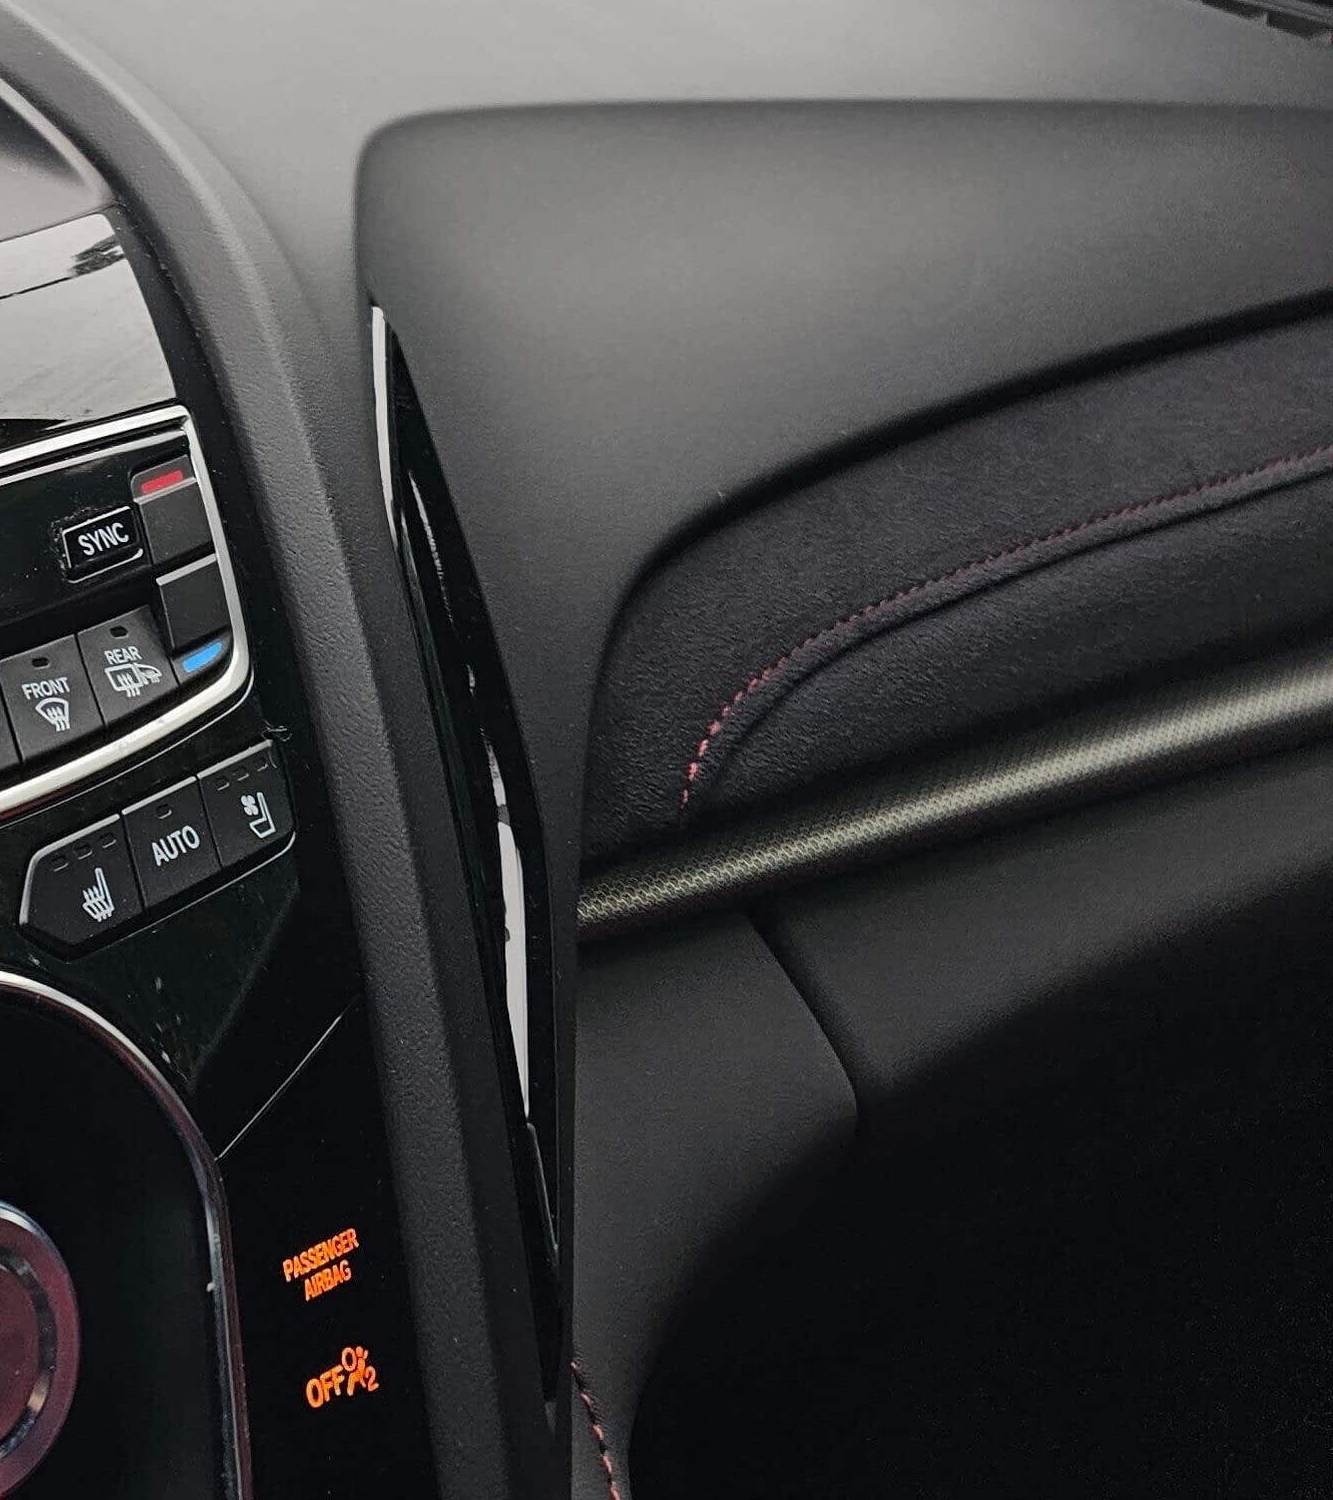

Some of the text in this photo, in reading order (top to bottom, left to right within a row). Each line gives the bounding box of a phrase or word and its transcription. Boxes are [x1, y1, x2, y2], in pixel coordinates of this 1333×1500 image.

[78, 522, 130, 557] SYNC
[104, 646, 141, 664] REAR
[22, 677, 70, 701] FRONT
[151, 825, 200, 867] AUTO
[282, 1228, 360, 1284] PASSENGER
[303, 1259, 352, 1301] AIRBAG
[305, 1363, 346, 1408] OFF
